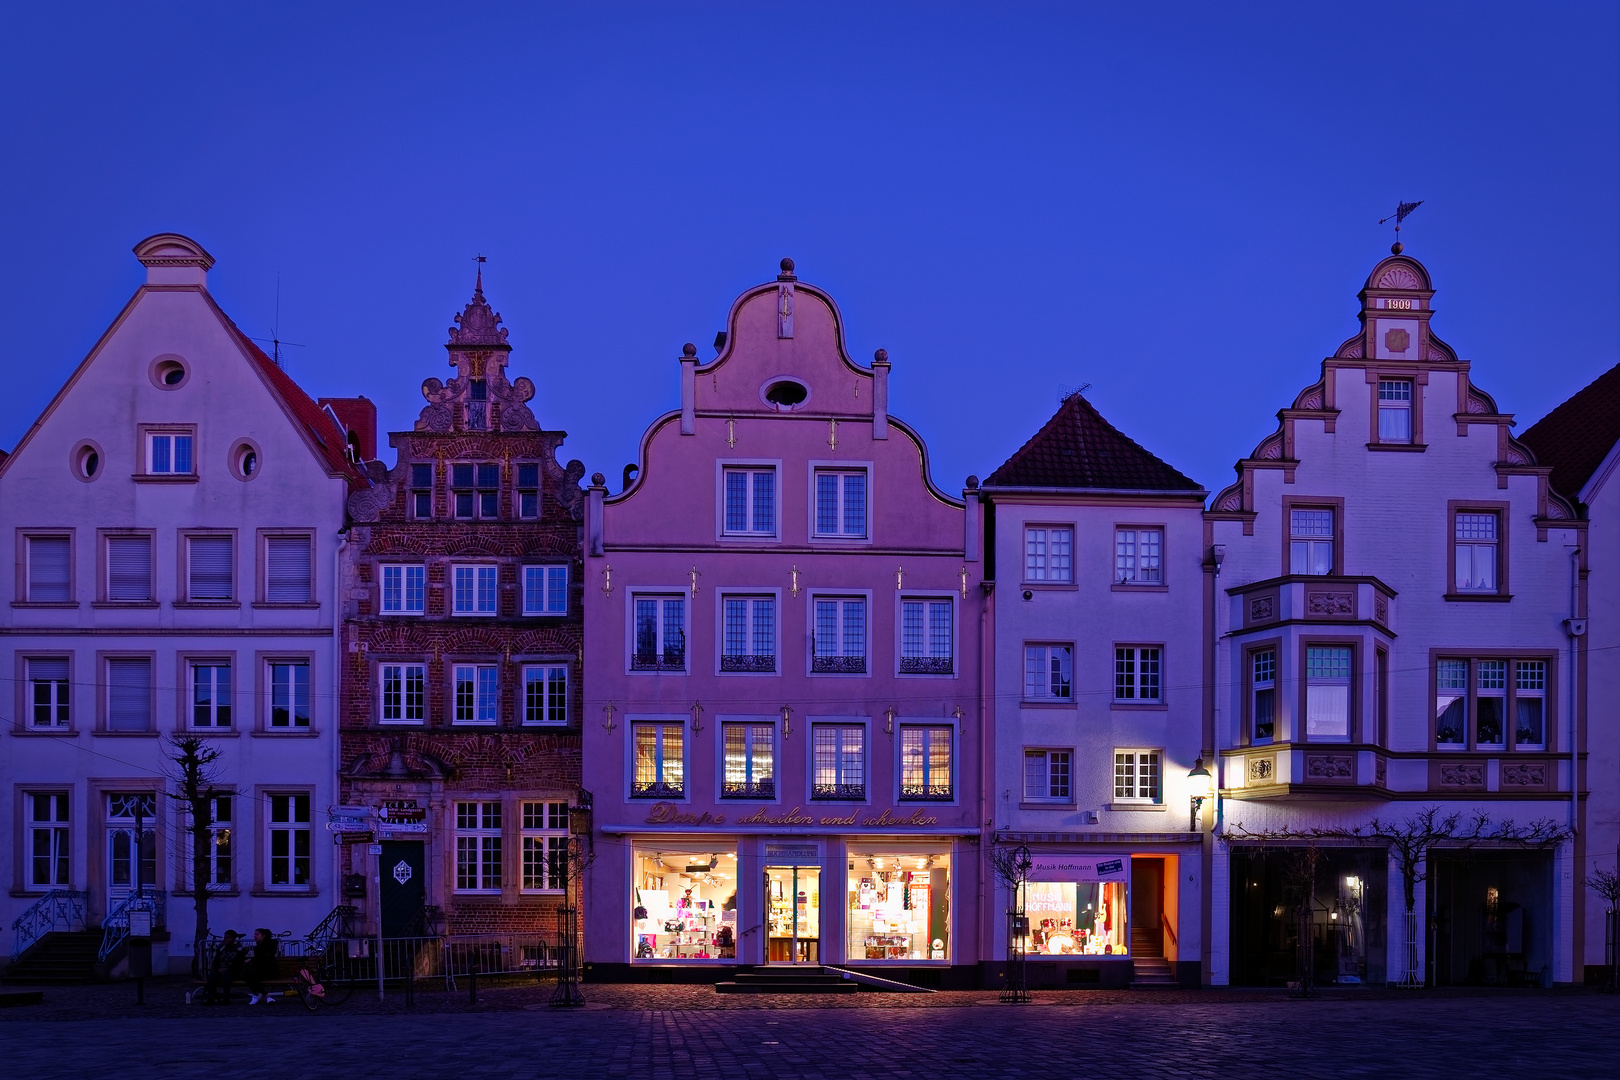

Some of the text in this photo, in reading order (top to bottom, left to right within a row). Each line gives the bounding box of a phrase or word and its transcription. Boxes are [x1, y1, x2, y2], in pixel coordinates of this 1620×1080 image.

[1387, 299, 1411, 310] 1909
[737, 806, 814, 825] schreiben
[820, 808, 860, 825] und
[862, 807, 939, 826] schenken
[1058, 863, 1092, 871] Hoffmann
[1032, 892, 1062, 902] MUSIK
[1025, 902, 1072, 912] HOFFMANN
